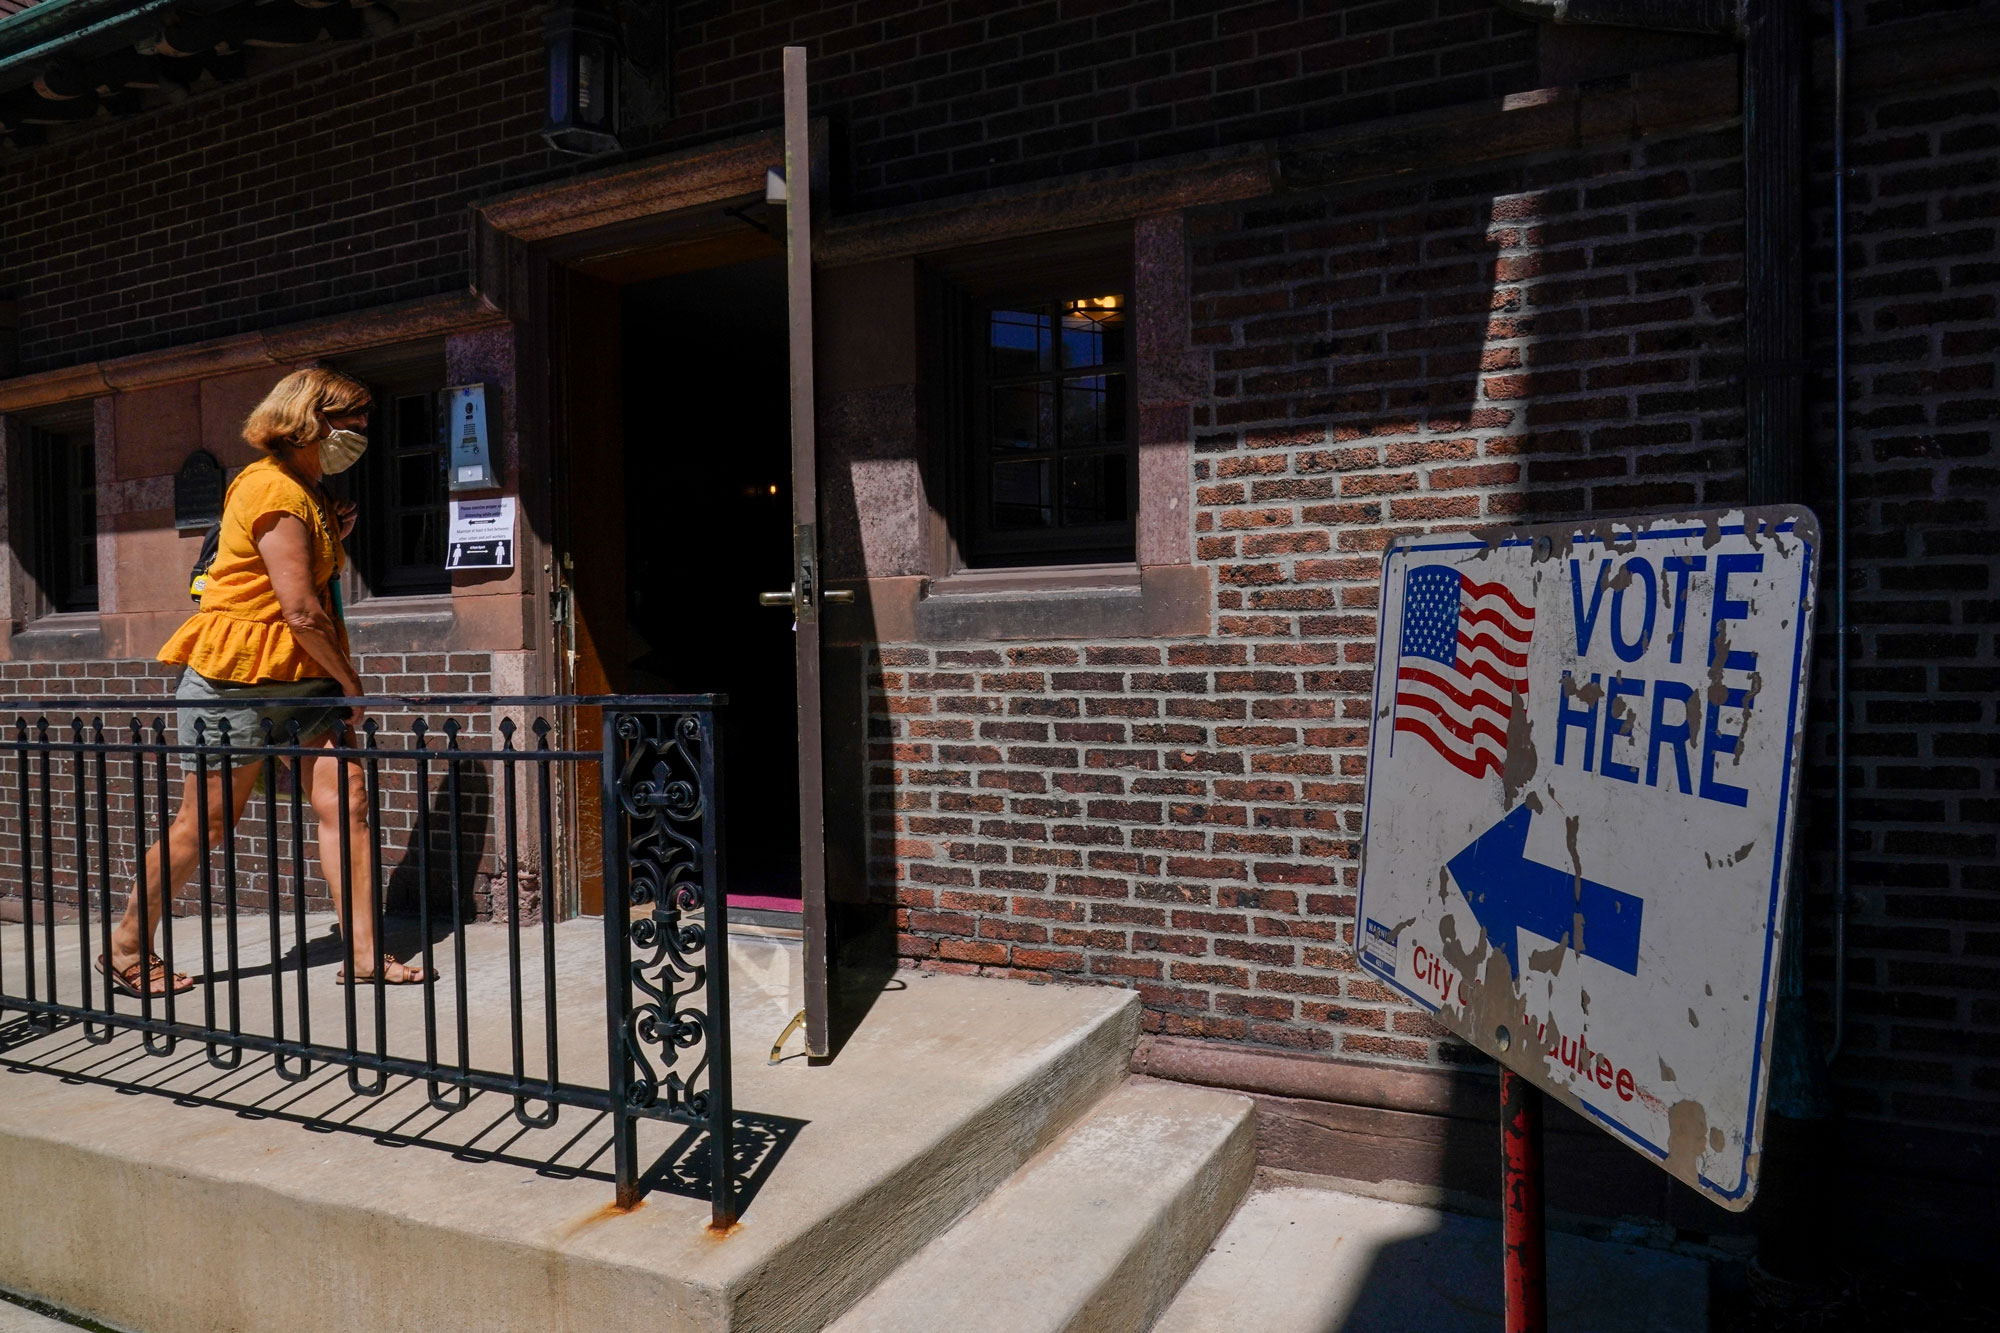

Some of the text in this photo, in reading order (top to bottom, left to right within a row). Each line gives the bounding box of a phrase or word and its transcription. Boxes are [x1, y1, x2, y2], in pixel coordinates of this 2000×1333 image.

[1570, 553, 1764, 671] VOTE
[1554, 670, 1756, 808] HERE
[1413, 946, 1454, 1001] City
